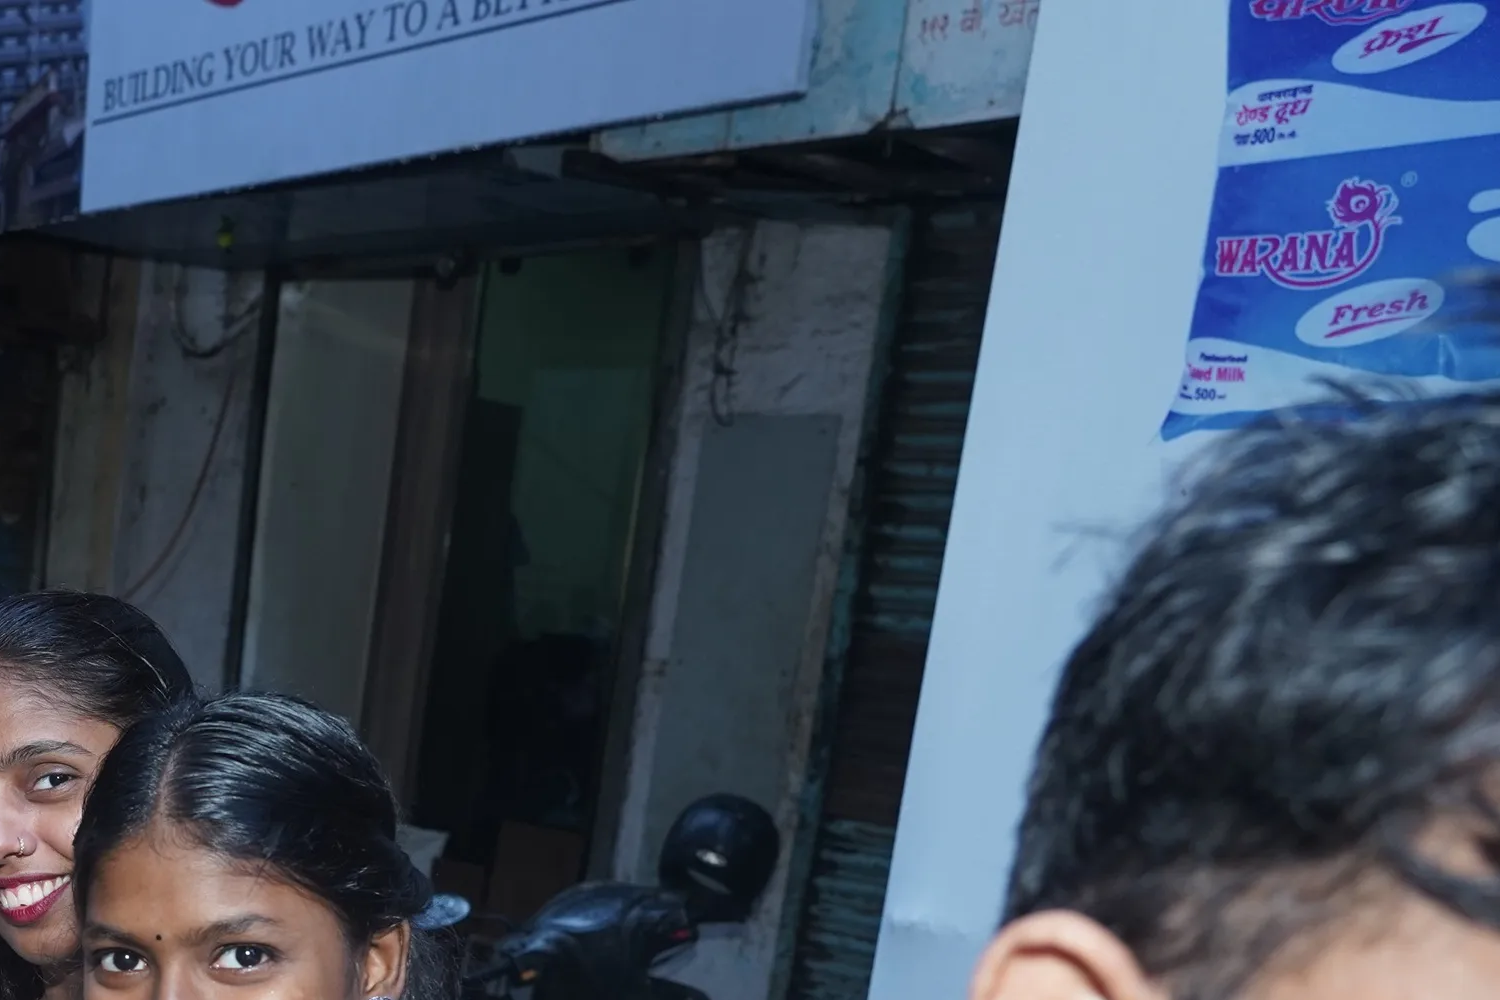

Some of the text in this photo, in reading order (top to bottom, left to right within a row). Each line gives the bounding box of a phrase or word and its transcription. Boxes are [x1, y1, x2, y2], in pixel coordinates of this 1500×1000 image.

[103, 52, 215, 113] BUILDING
[222, 30, 296, 84] YOUR
[306, 10, 373, 62] WAY
[382, 0, 428, 42] TO
[436, 0, 461, 30] A
[1250, 127, 1276, 146] 500
[1217, 230, 1360, 280] WARANA
[1328, 289, 1430, 327] Fresh
[1216, 366, 1245, 382] Milk
[1194, 387, 1216, 401] 500
